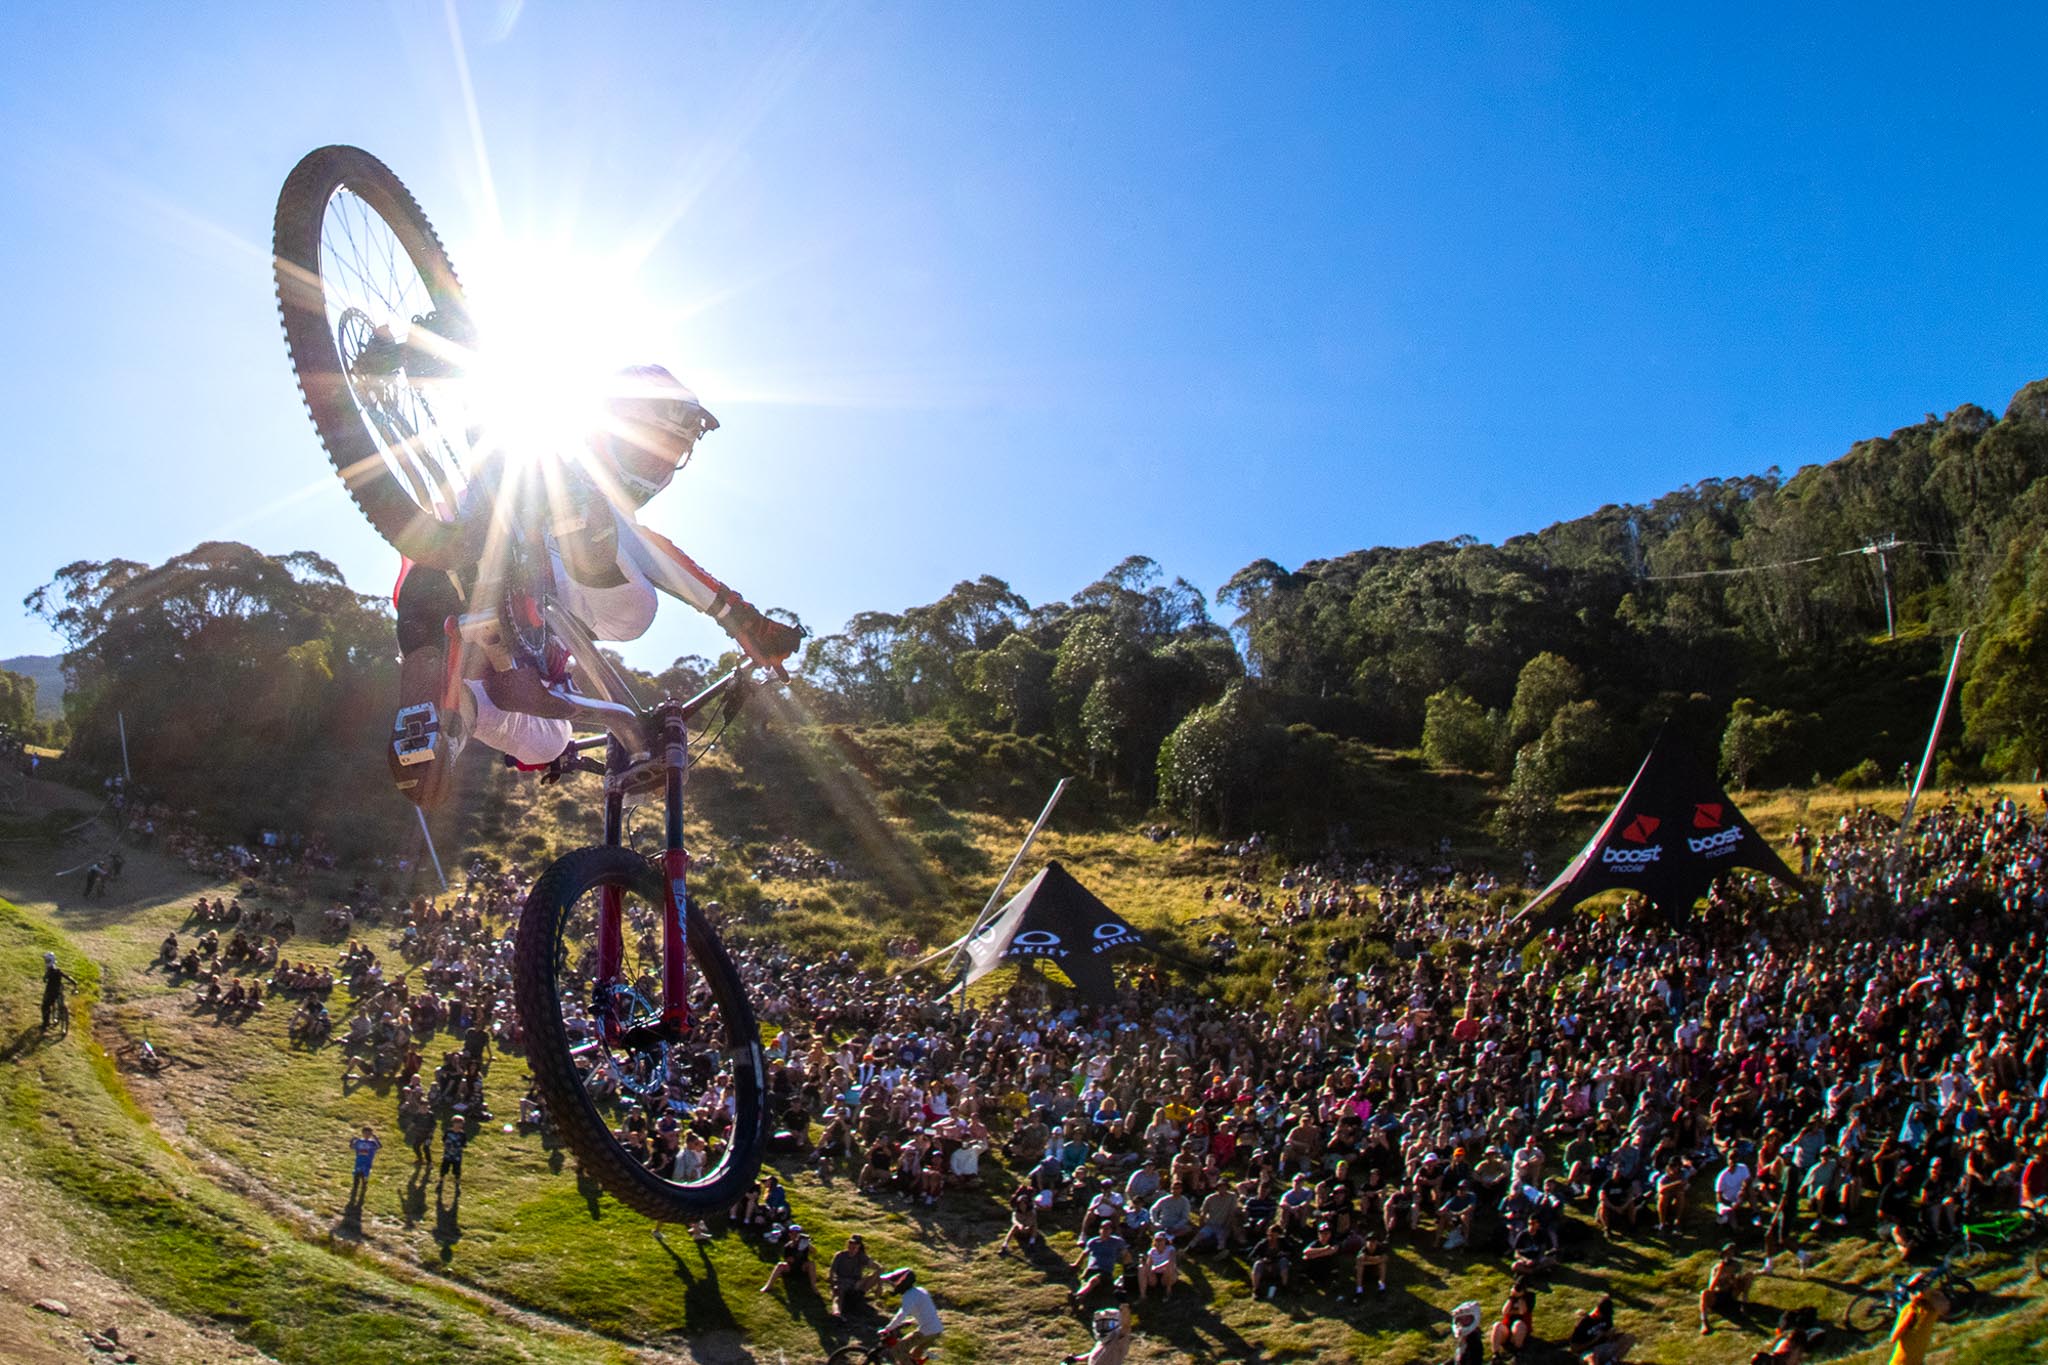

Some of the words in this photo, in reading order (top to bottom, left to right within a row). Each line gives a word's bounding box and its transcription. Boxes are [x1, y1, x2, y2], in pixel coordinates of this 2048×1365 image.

[1688, 826, 1744, 852] boost
[1602, 845, 1662, 863] boost
[1609, 864, 1645, 873] mobile
